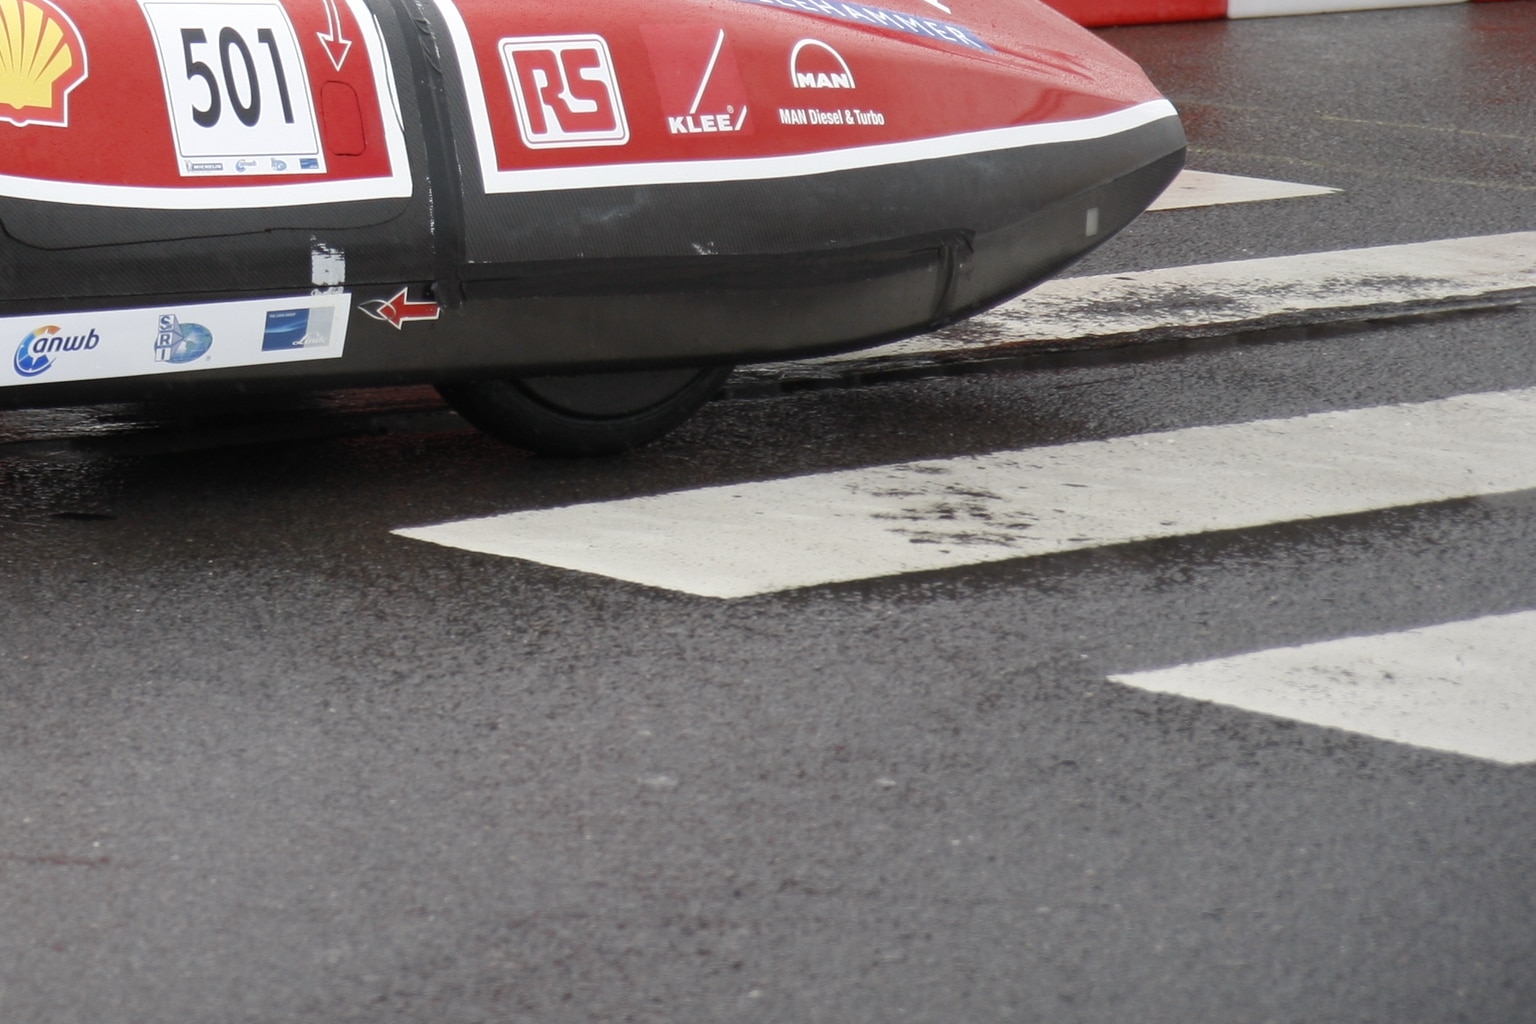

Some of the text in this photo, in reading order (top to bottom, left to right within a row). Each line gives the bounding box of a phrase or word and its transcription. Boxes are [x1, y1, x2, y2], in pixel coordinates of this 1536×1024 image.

[179, 26, 296, 129] 501
[796, 72, 851, 89] MAN
[511, 48, 618, 135] RS
[778, 108, 886, 126] MAN Diesel & Turbo
[32, 328, 100, 354] anwb
